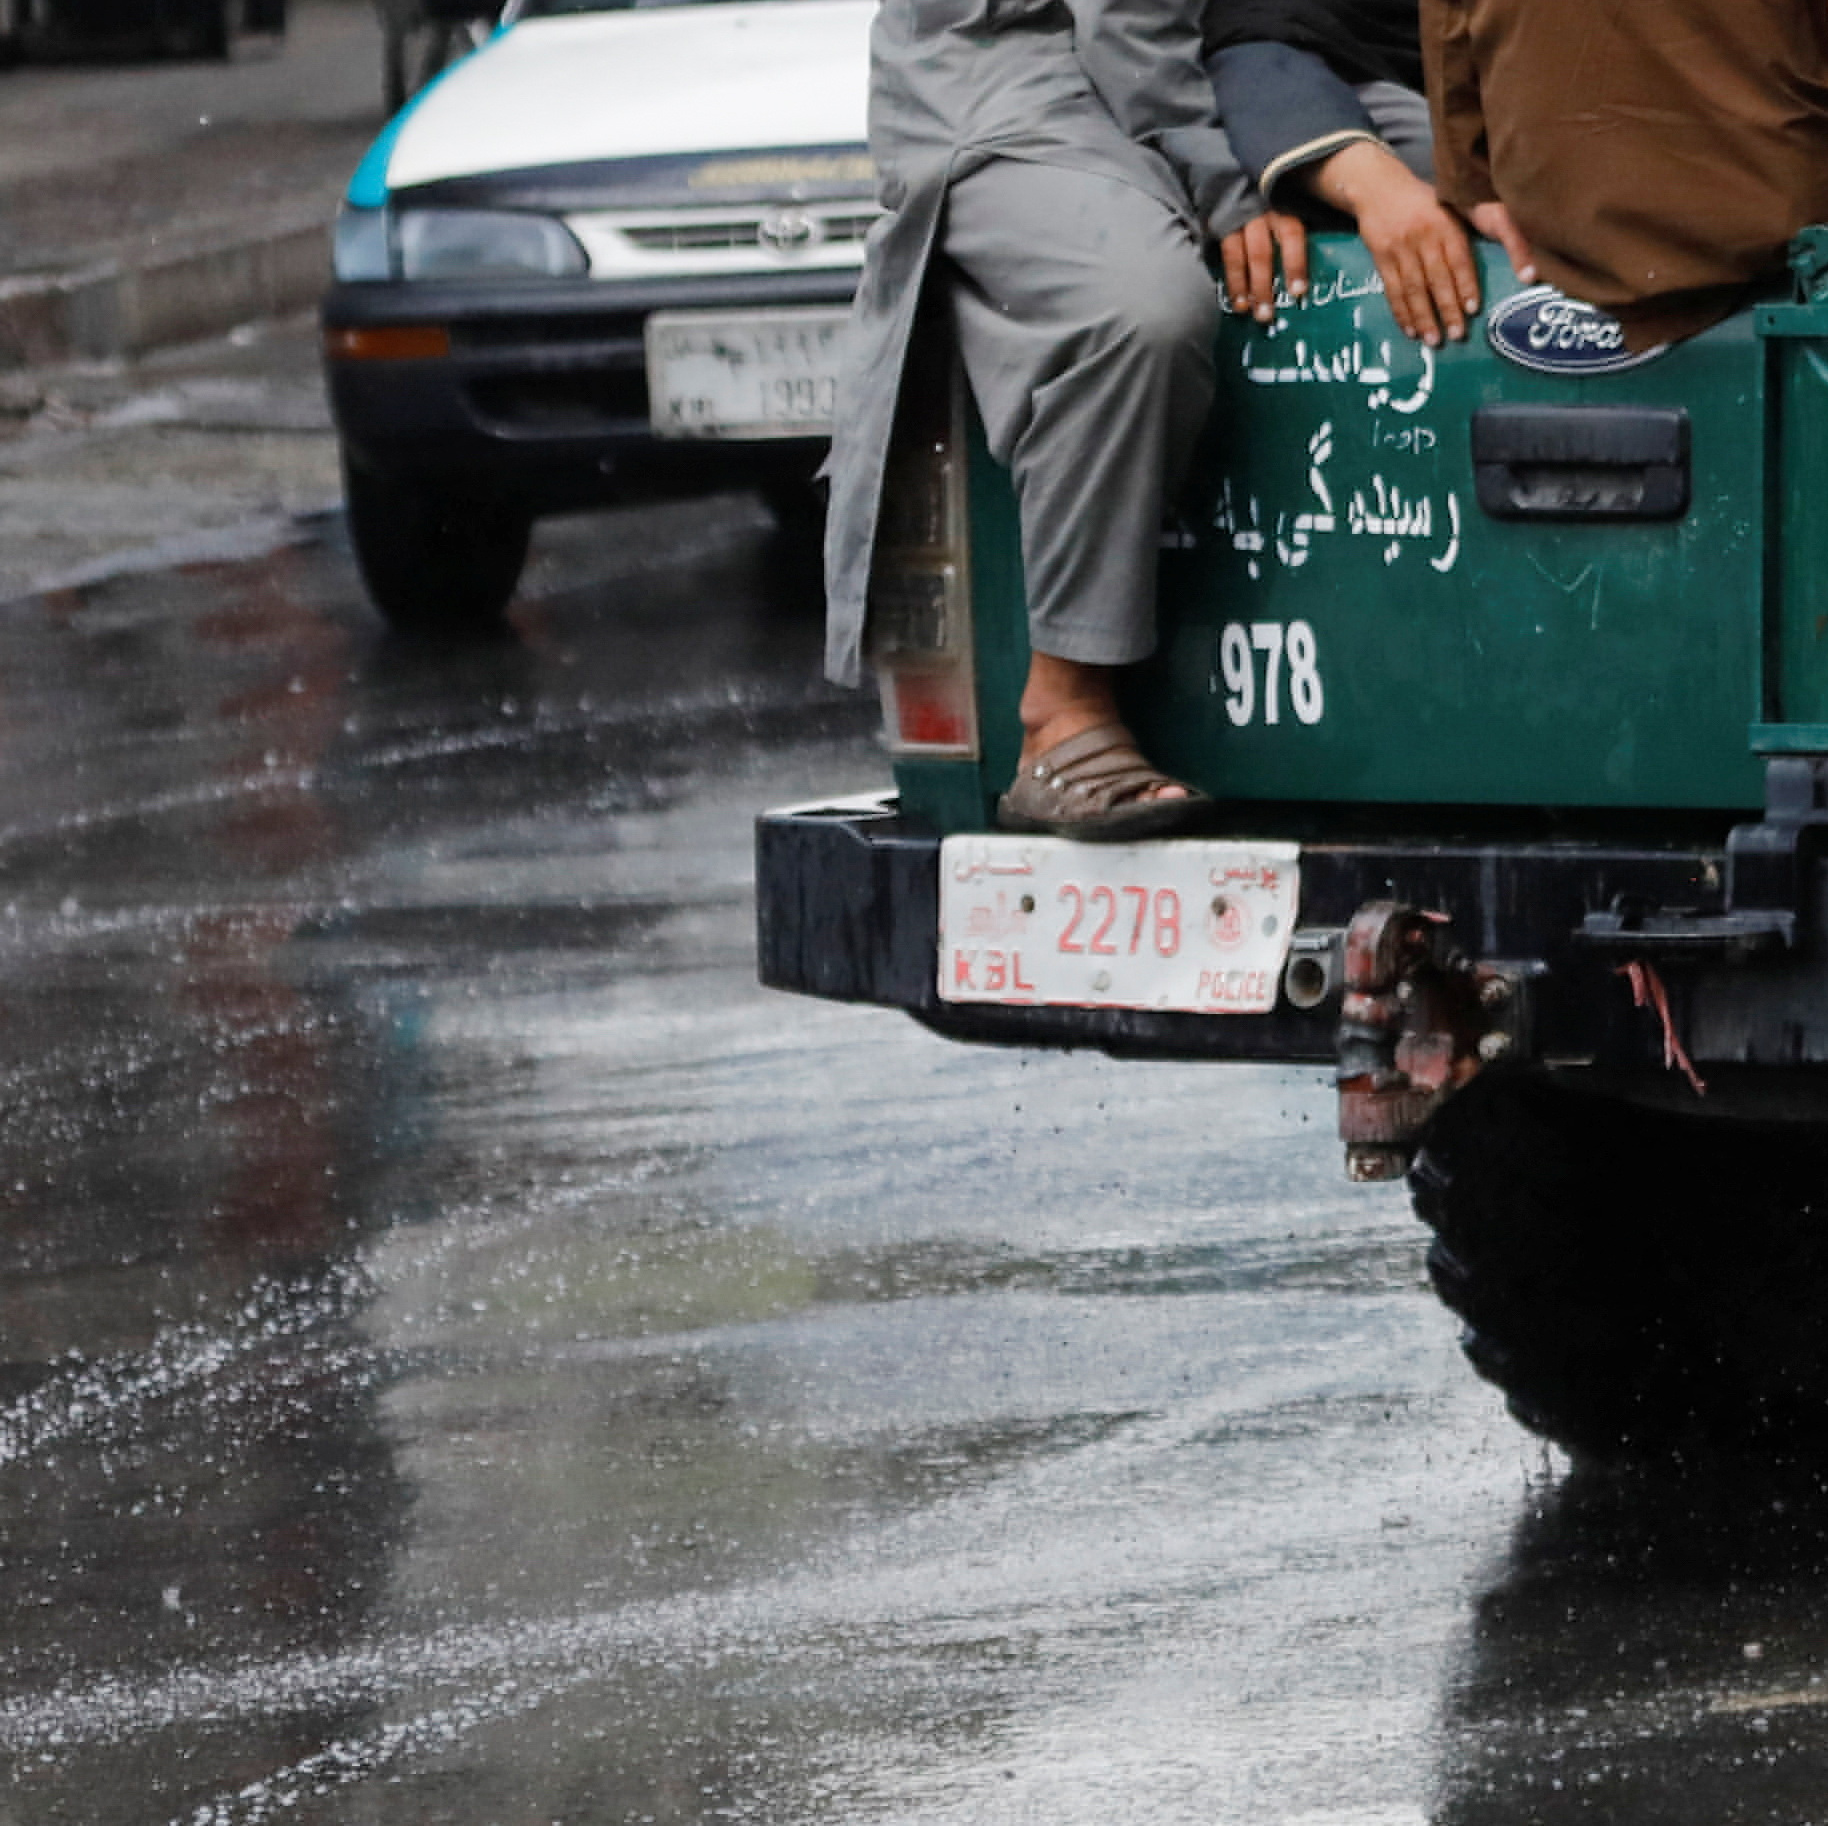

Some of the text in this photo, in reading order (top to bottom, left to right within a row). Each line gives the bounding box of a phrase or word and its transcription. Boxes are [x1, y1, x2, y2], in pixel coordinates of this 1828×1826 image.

[1220, 618, 1325, 726] 978
[1057, 884, 1182, 957] 2278
[953, 948, 1036, 992] KBL
